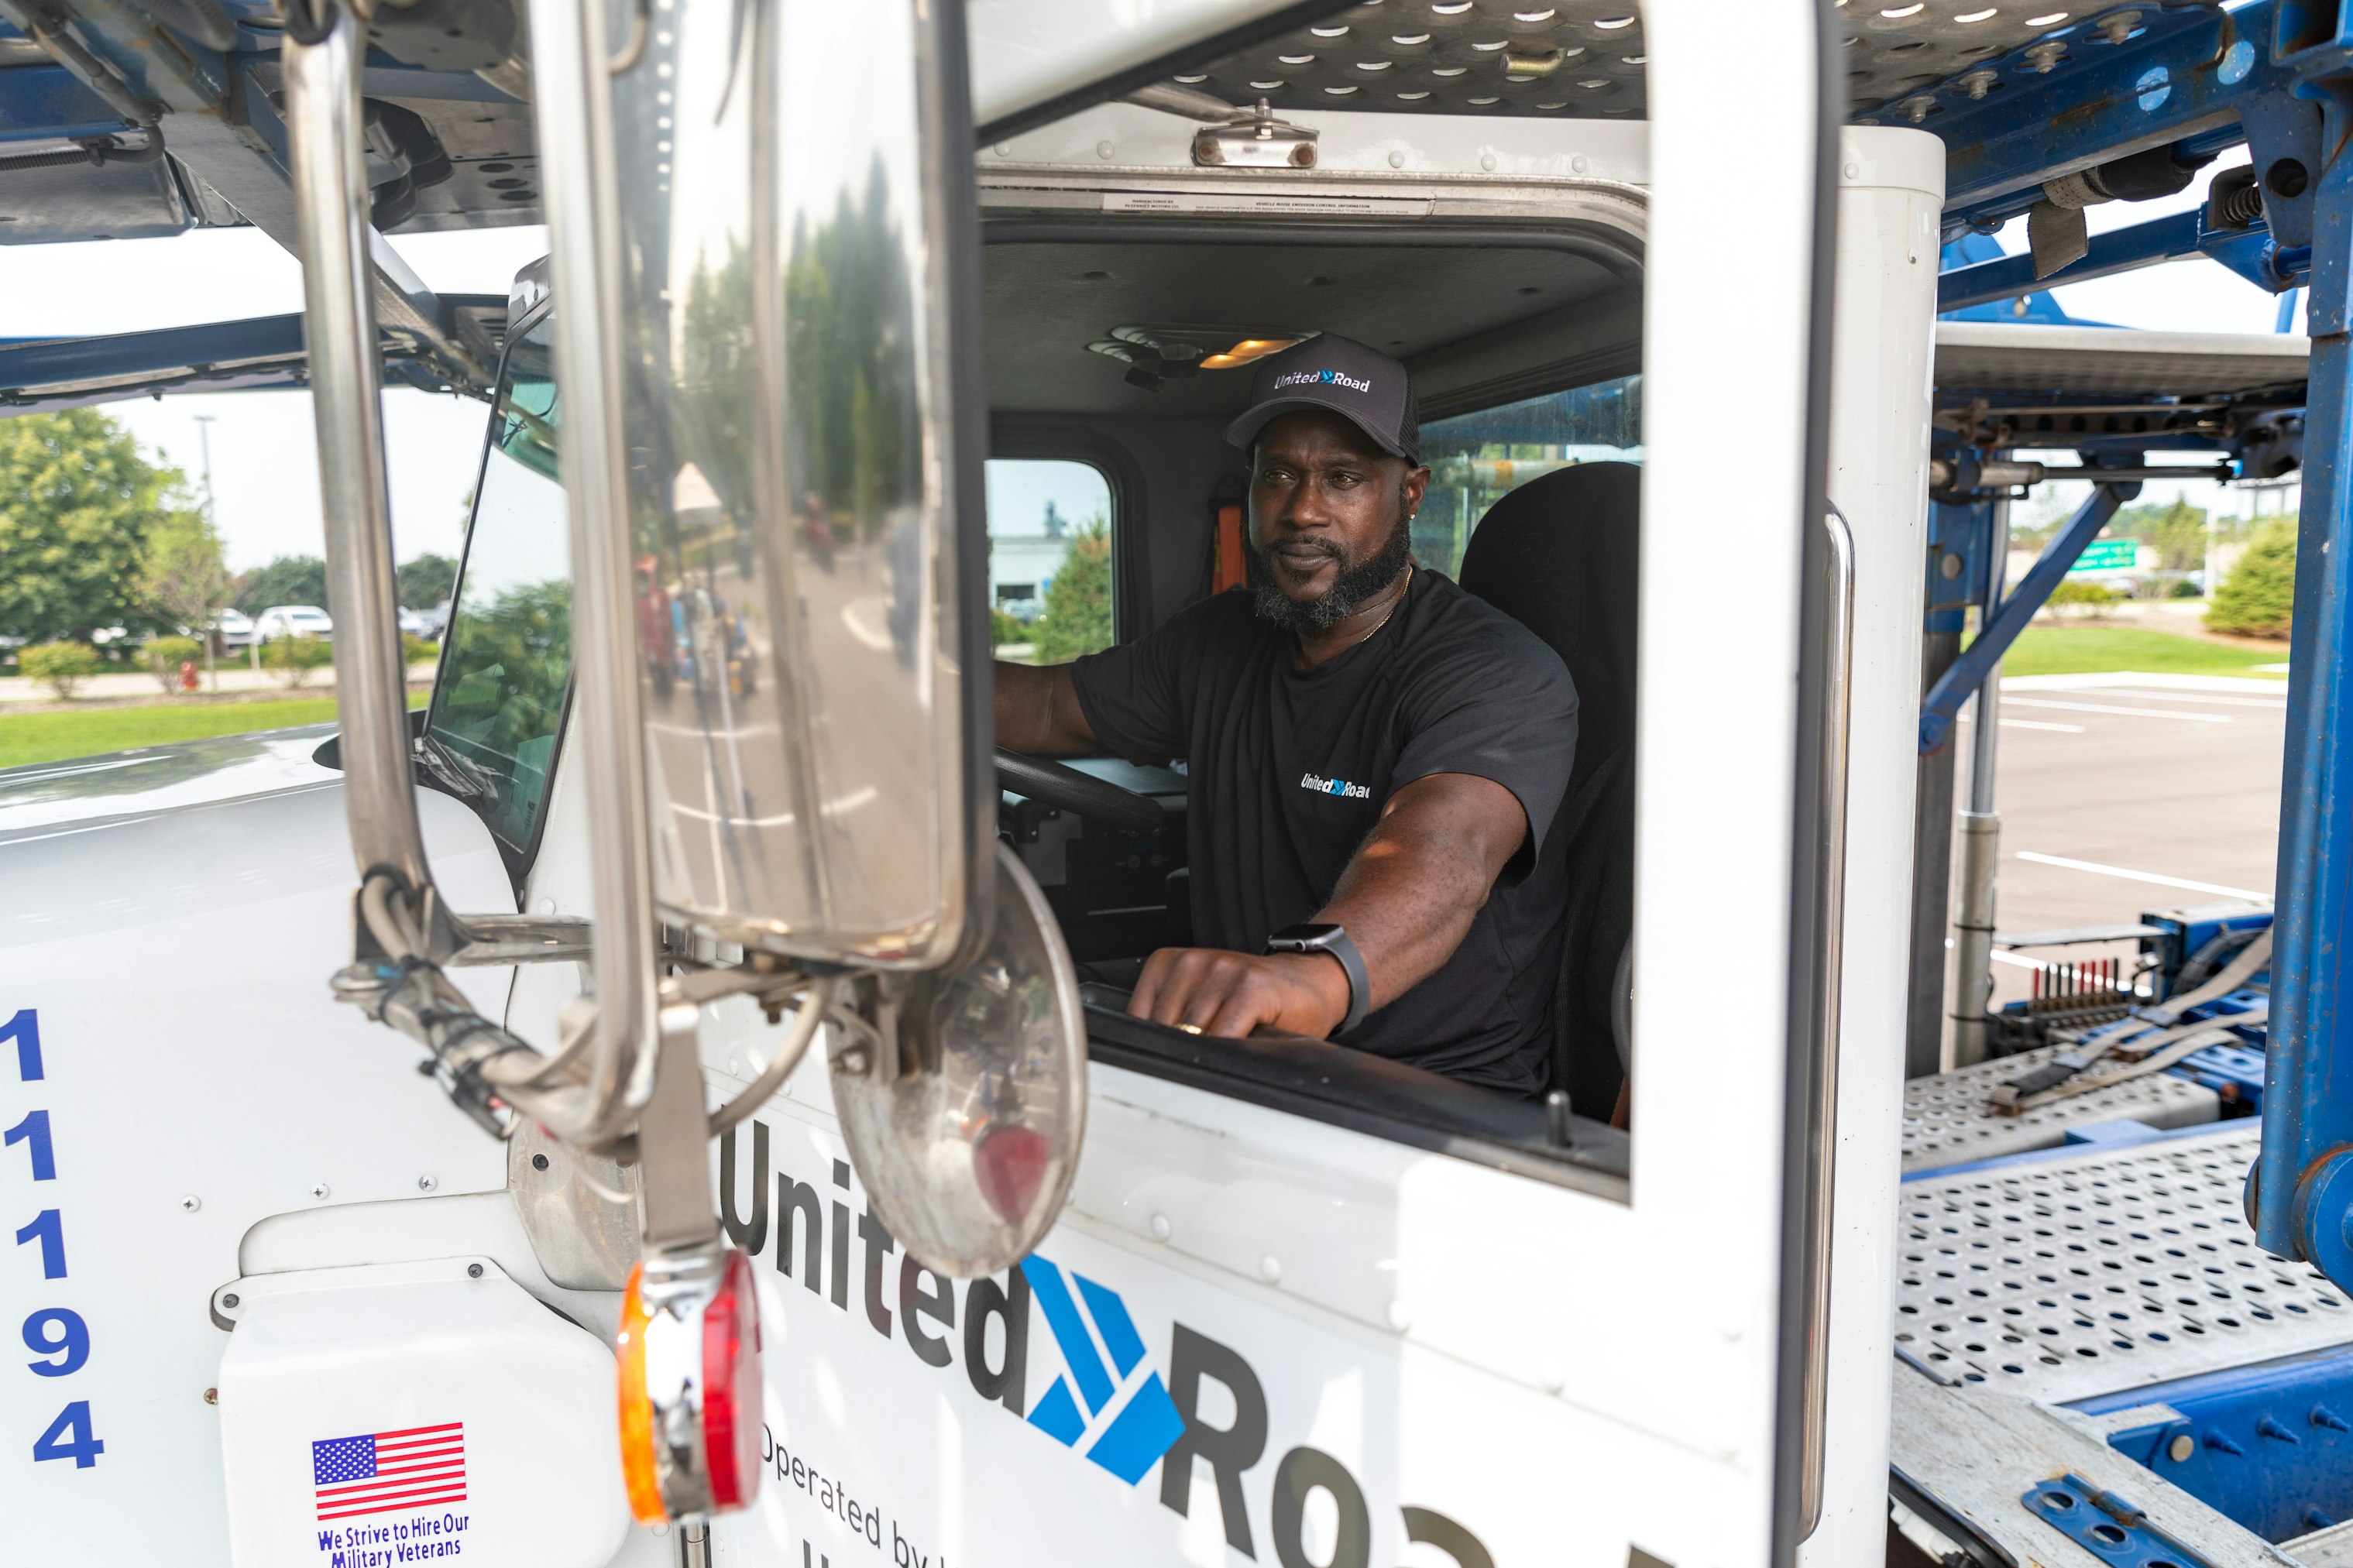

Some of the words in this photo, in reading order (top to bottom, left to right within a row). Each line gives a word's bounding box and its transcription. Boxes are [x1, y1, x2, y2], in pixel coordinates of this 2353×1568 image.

[1274, 371, 1320, 389] United
[1332, 372, 1371, 393] Road
[1301, 773, 1334, 793] United
[720, 1104, 1031, 1419] United
[318, 1530, 342, 1551] We
[346, 1525, 390, 1547] Strive
[393, 1523, 408, 1540] to
[411, 1517, 441, 1538] Hire
[444, 1513, 469, 1532] Our
[331, 1549, 392, 1568] Military
[397, 1539, 461, 1563] Veterans
